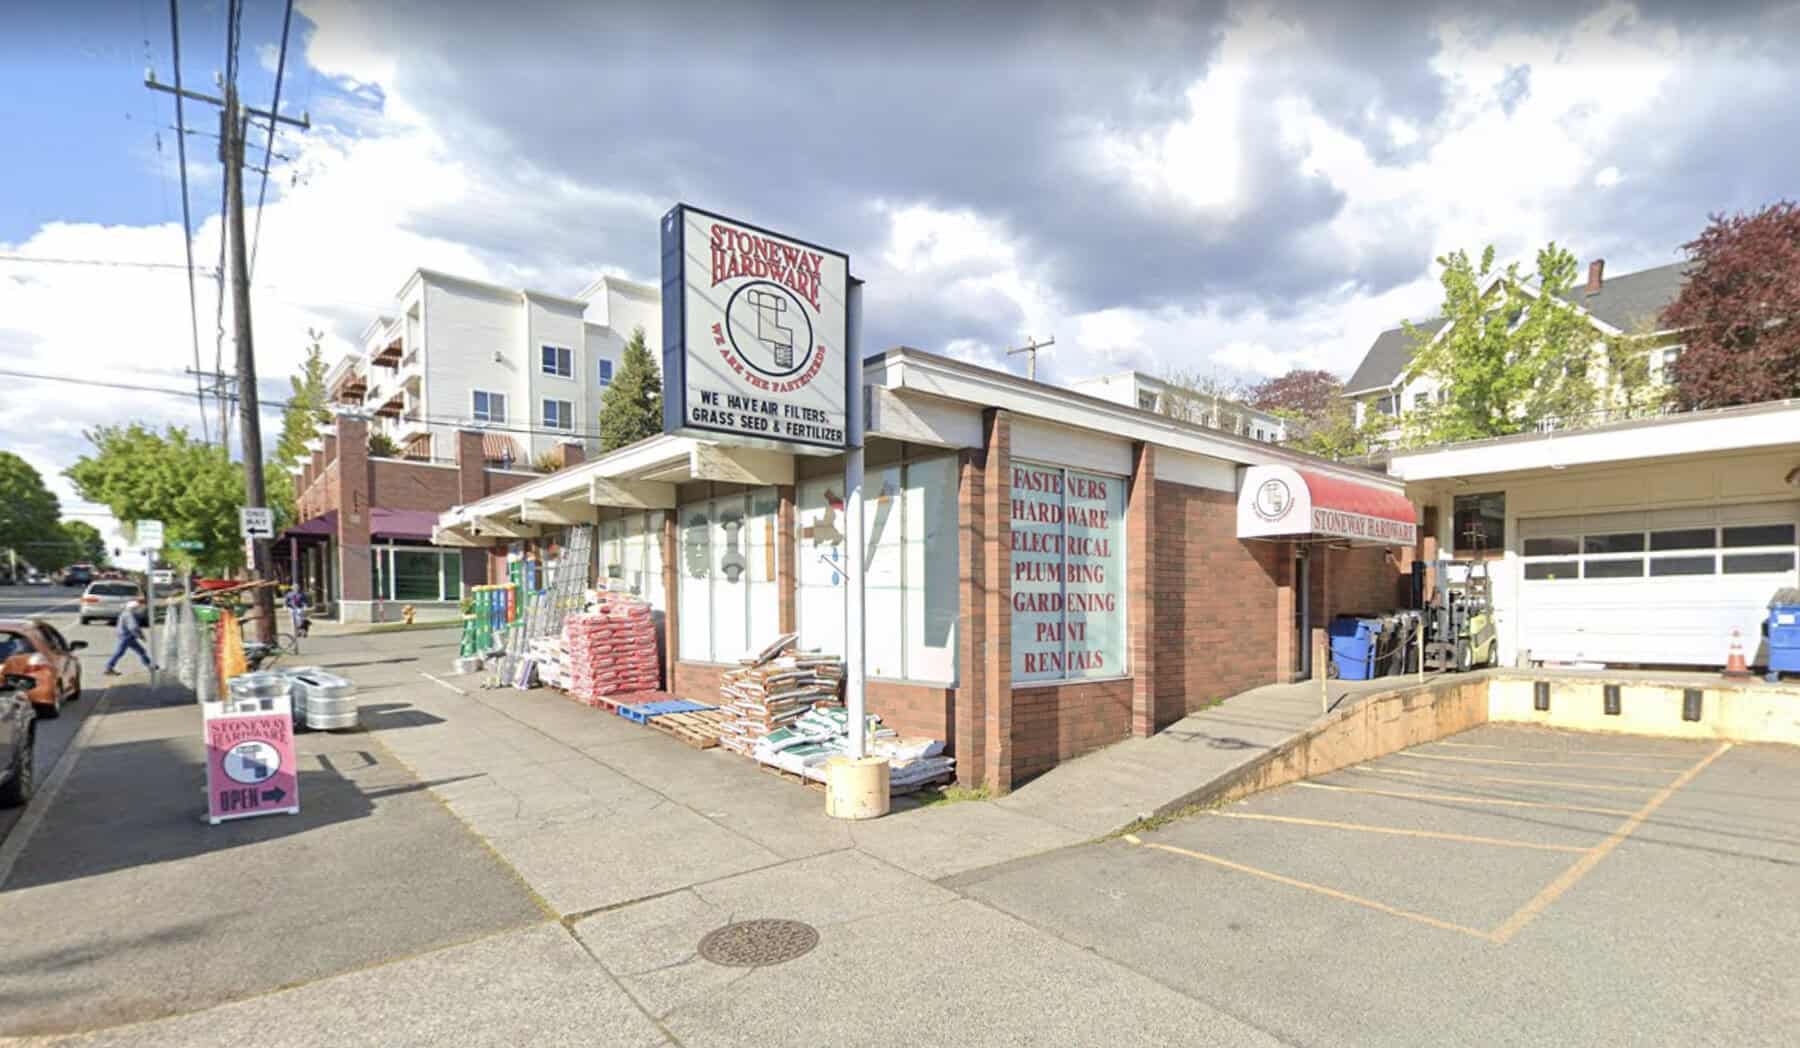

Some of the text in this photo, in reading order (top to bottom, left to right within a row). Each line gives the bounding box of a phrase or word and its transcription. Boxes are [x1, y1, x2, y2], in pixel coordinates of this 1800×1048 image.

[710, 223, 824, 274] STONEWAY
[710, 245, 822, 314] HARDWARE
[711, 321, 726, 346] WE
[720, 348, 742, 375] ARE
[744, 371, 769, 391] THE
[700, 390, 719, 406] WE
[727, 394, 758, 413] HAVE
[760, 399, 779, 415] AIR
[692, 408, 843, 443] GRASS SEED & FERTILIZER
[1013, 466, 1107, 500] FASTENERS
[1012, 499, 1109, 530] HARDWARE
[1314, 510, 1365, 535] STONEWAY
[1367, 518, 1413, 541] HARDWARE
[1011, 530, 1111, 557] ELECTRICAL
[1015, 562, 1104, 584] PLUMBING
[1013, 592, 1115, 613] GARDENING
[1035, 621, 1087, 642] PAINT
[1024, 650, 1104, 673] RENTALS
[211, 718, 287, 732] STONEWAY
[212, 729, 288, 751] HARDWARE
[220, 788, 259, 812] OPEN
